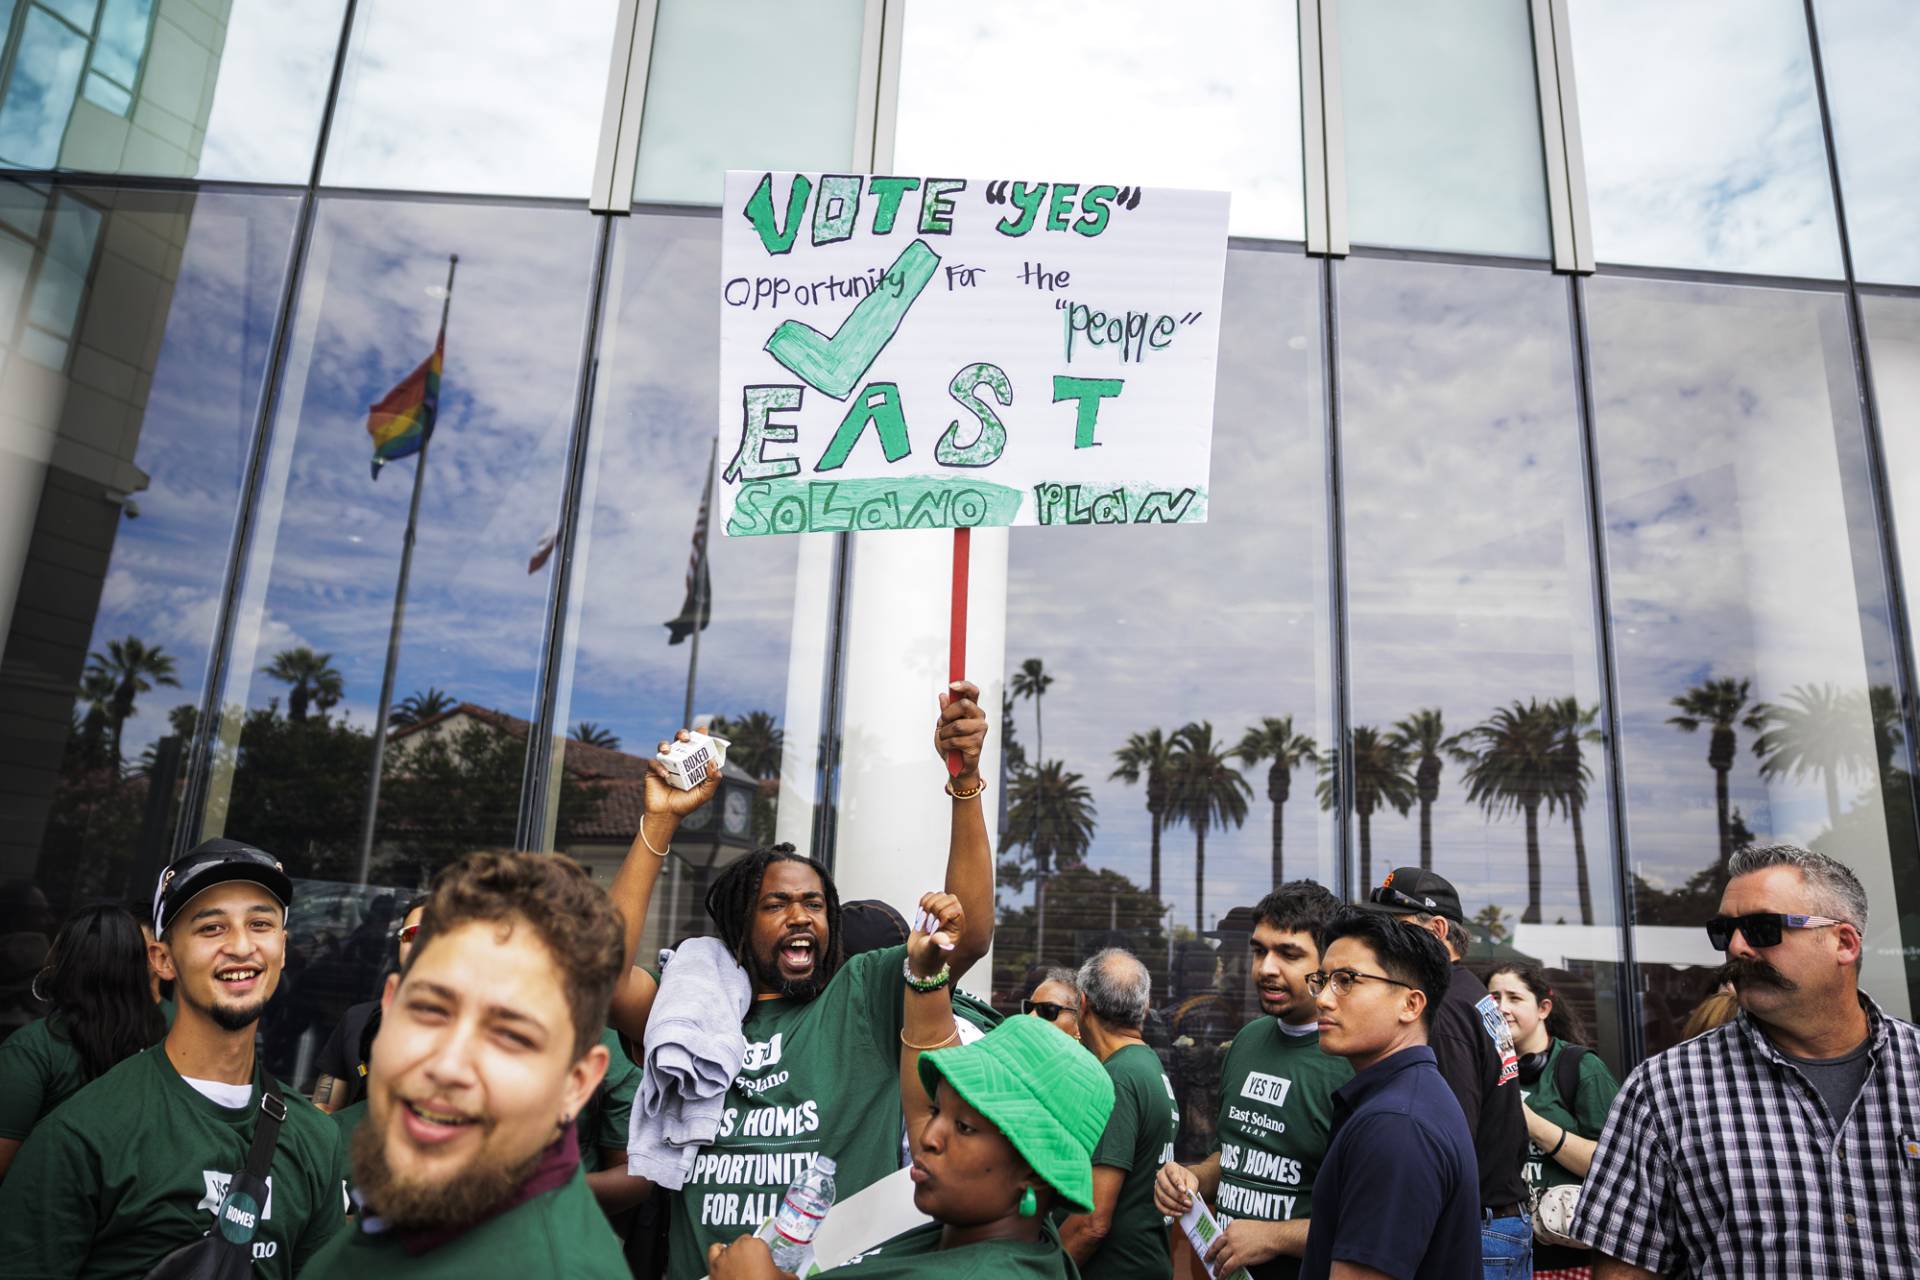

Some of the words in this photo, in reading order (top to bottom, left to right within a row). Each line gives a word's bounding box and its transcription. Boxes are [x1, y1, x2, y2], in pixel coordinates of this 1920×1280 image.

[743, 172, 967, 255] VOTE
[945, 263, 986, 291] For
[1017, 261, 1071, 291] the
[722, 362, 1125, 483] EAST
[682, 746, 710, 773] BOXED
[735, 1070, 789, 1093] Solano
[1248, 1076, 1268, 1096] YES
[1268, 1081, 1283, 1101] TO
[743, 1100, 820, 1137] HOMES
[1228, 1105, 1251, 1123] East
[1250, 1111, 1286, 1134] Solano
[1240, 1124, 1268, 1138] PLAN
[1242, 1148, 1302, 1185] HOMES
[225, 1204, 256, 1229] HOMES
[701, 1193, 740, 1226] FOR
